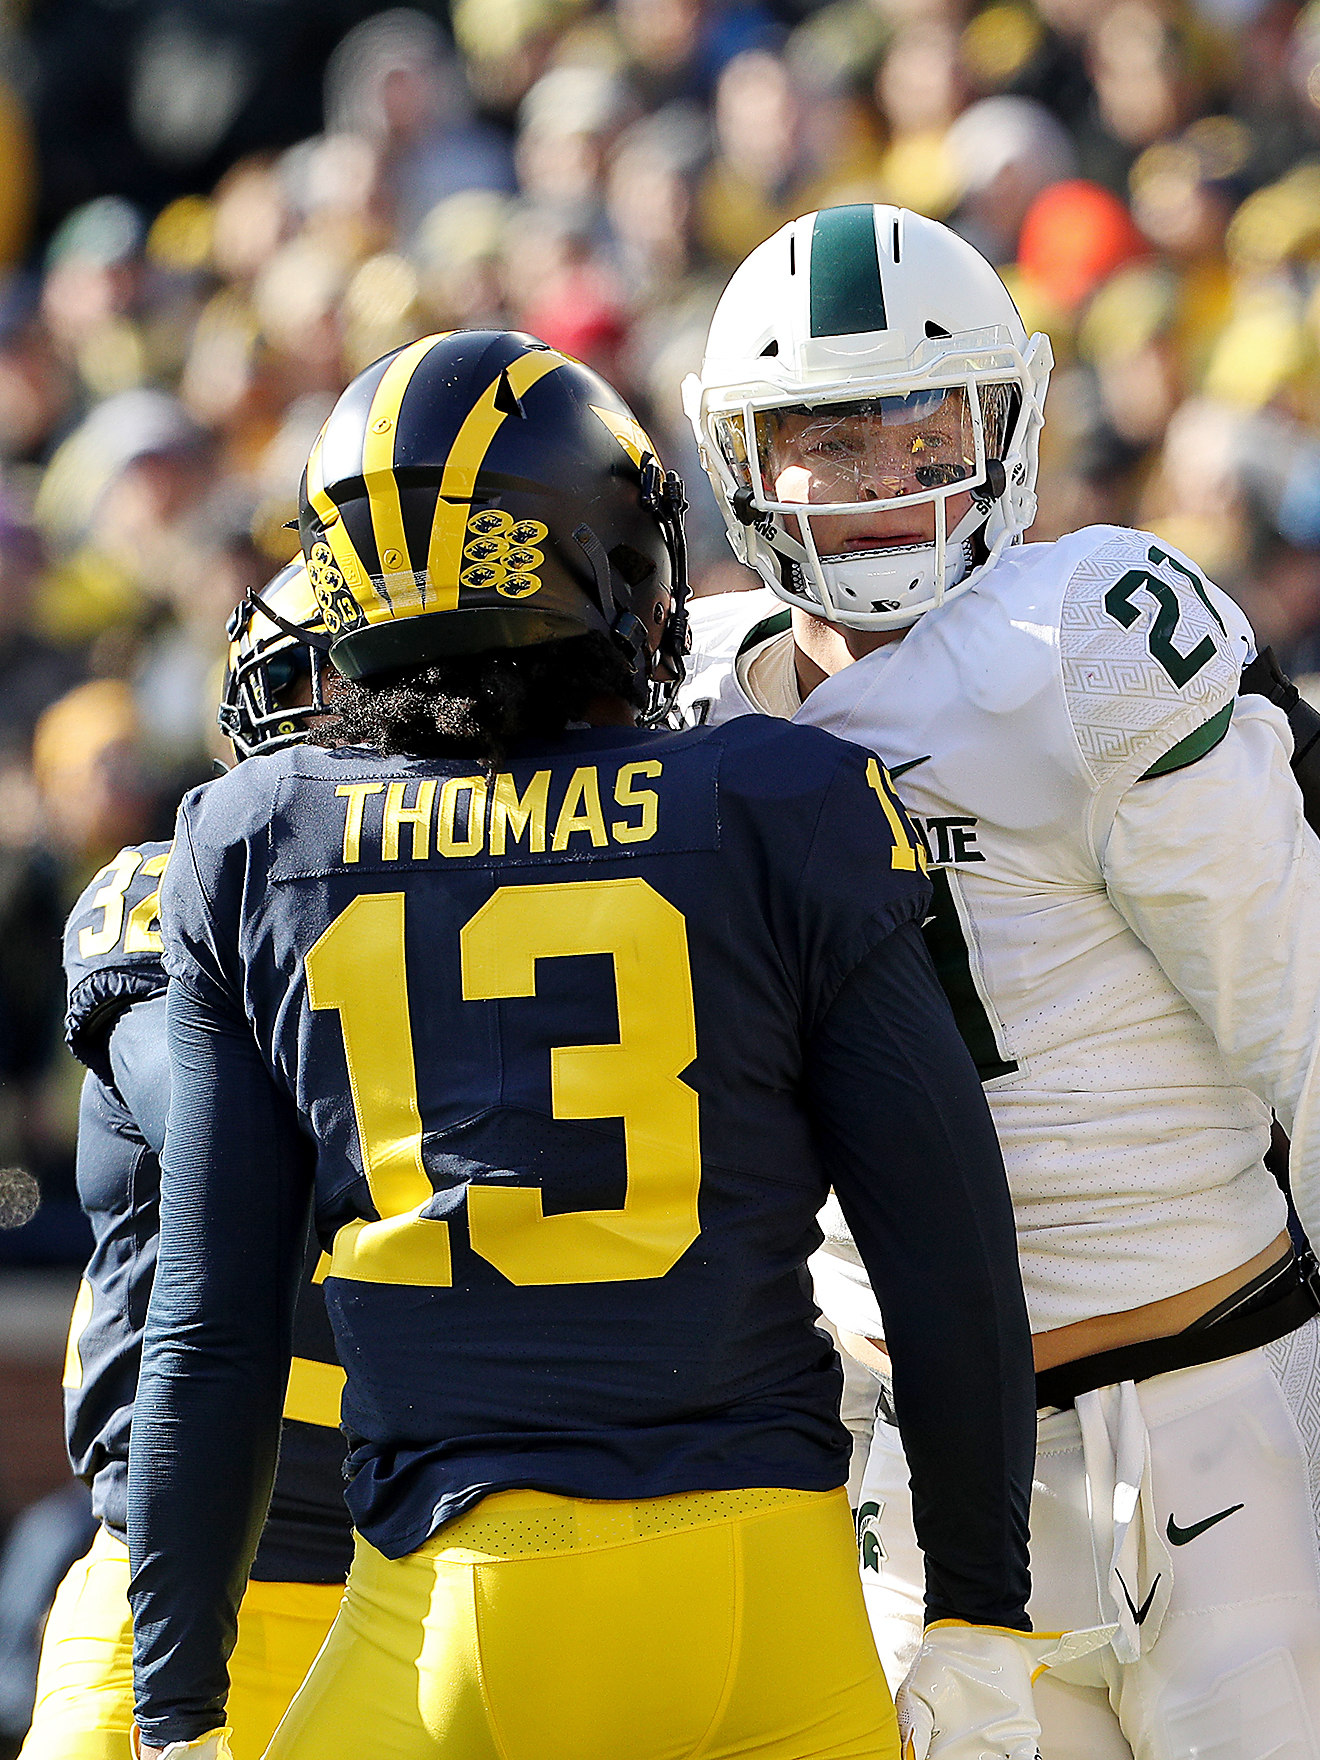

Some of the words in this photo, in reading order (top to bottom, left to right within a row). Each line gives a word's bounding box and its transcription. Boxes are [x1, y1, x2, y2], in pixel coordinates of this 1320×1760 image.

[336, 596, 359, 624] 13
[334, 759, 663, 864] THOMAS
[77, 850, 171, 960] 32
[303, 876, 702, 1287] 13
